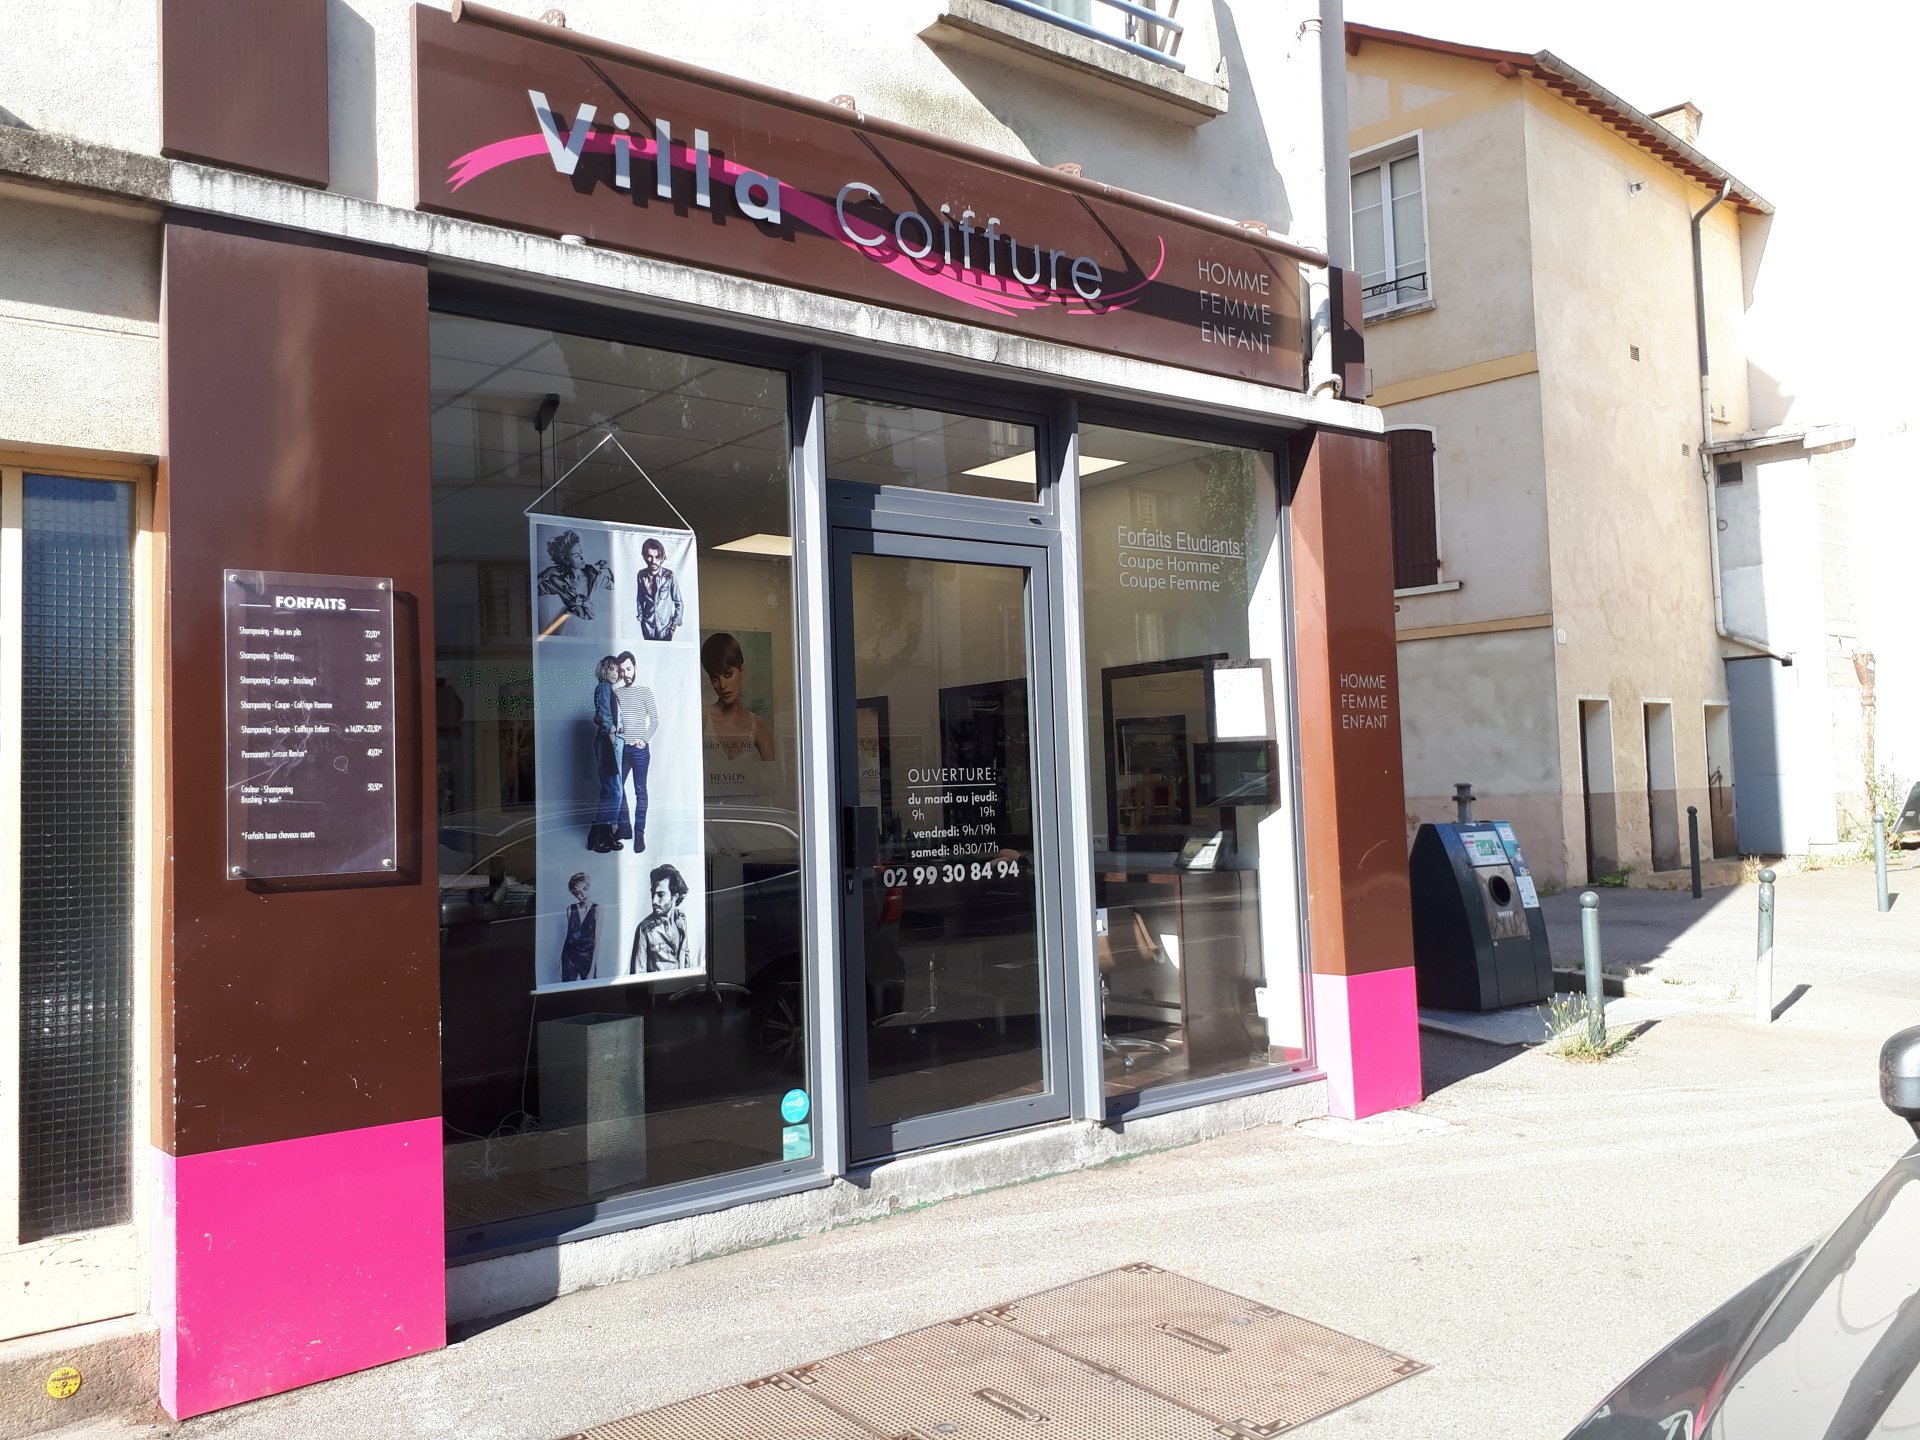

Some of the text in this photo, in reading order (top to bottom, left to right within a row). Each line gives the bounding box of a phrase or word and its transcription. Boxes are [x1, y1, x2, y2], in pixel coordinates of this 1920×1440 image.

[528, 89, 1103, 300] Villa Coiffure
[1198, 259, 1269, 296] HOMME
[1200, 289, 1271, 325] FEMME
[1201, 321, 1271, 354] ENFANT
[1117, 525, 1172, 549] Forfaits
[1119, 552, 1220, 574] Coupe Homme
[1119, 572, 1220, 592] Coupe Femme
[275, 596, 347, 610] FORFAITS
[239, 626, 269, 636] Shampooing
[240, 651, 270, 661] Shampooing
[274, 651, 295, 661] Brushing
[240, 676, 271, 685] Shampooing
[274, 676, 290, 685] Coupe
[1340, 673, 1386, 689] HOMME
[240, 701, 271, 710] Shampooing
[275, 701, 290, 710] Coupe
[314, 701, 333, 709] Homme
[1341, 694, 1387, 709] FEMME
[1342, 714, 1388, 729] ENFANT
[241, 725, 272, 735] Shampooing
[275, 725, 291, 734] Coupe
[314, 725, 330, 733] Enfant
[271, 749, 288, 757] Sensor
[907, 767, 996, 783] OUVERTURE:
[241, 785, 259, 793] Couleur
[263, 785, 294, 795] Shampooing
[908, 790, 998, 805] du mardi au jeudi:
[241, 796, 262, 805] Brushing
[912, 806, 995, 820] 9h 19h
[265, 831, 278, 839] base
[278, 830, 299, 838] cheveux
[913, 824, 996, 839] vendredi: 9h/19h
[911, 842, 999, 858] samedi: 8h30/17h
[883, 860, 1019, 888] 02 99 30 84 94
